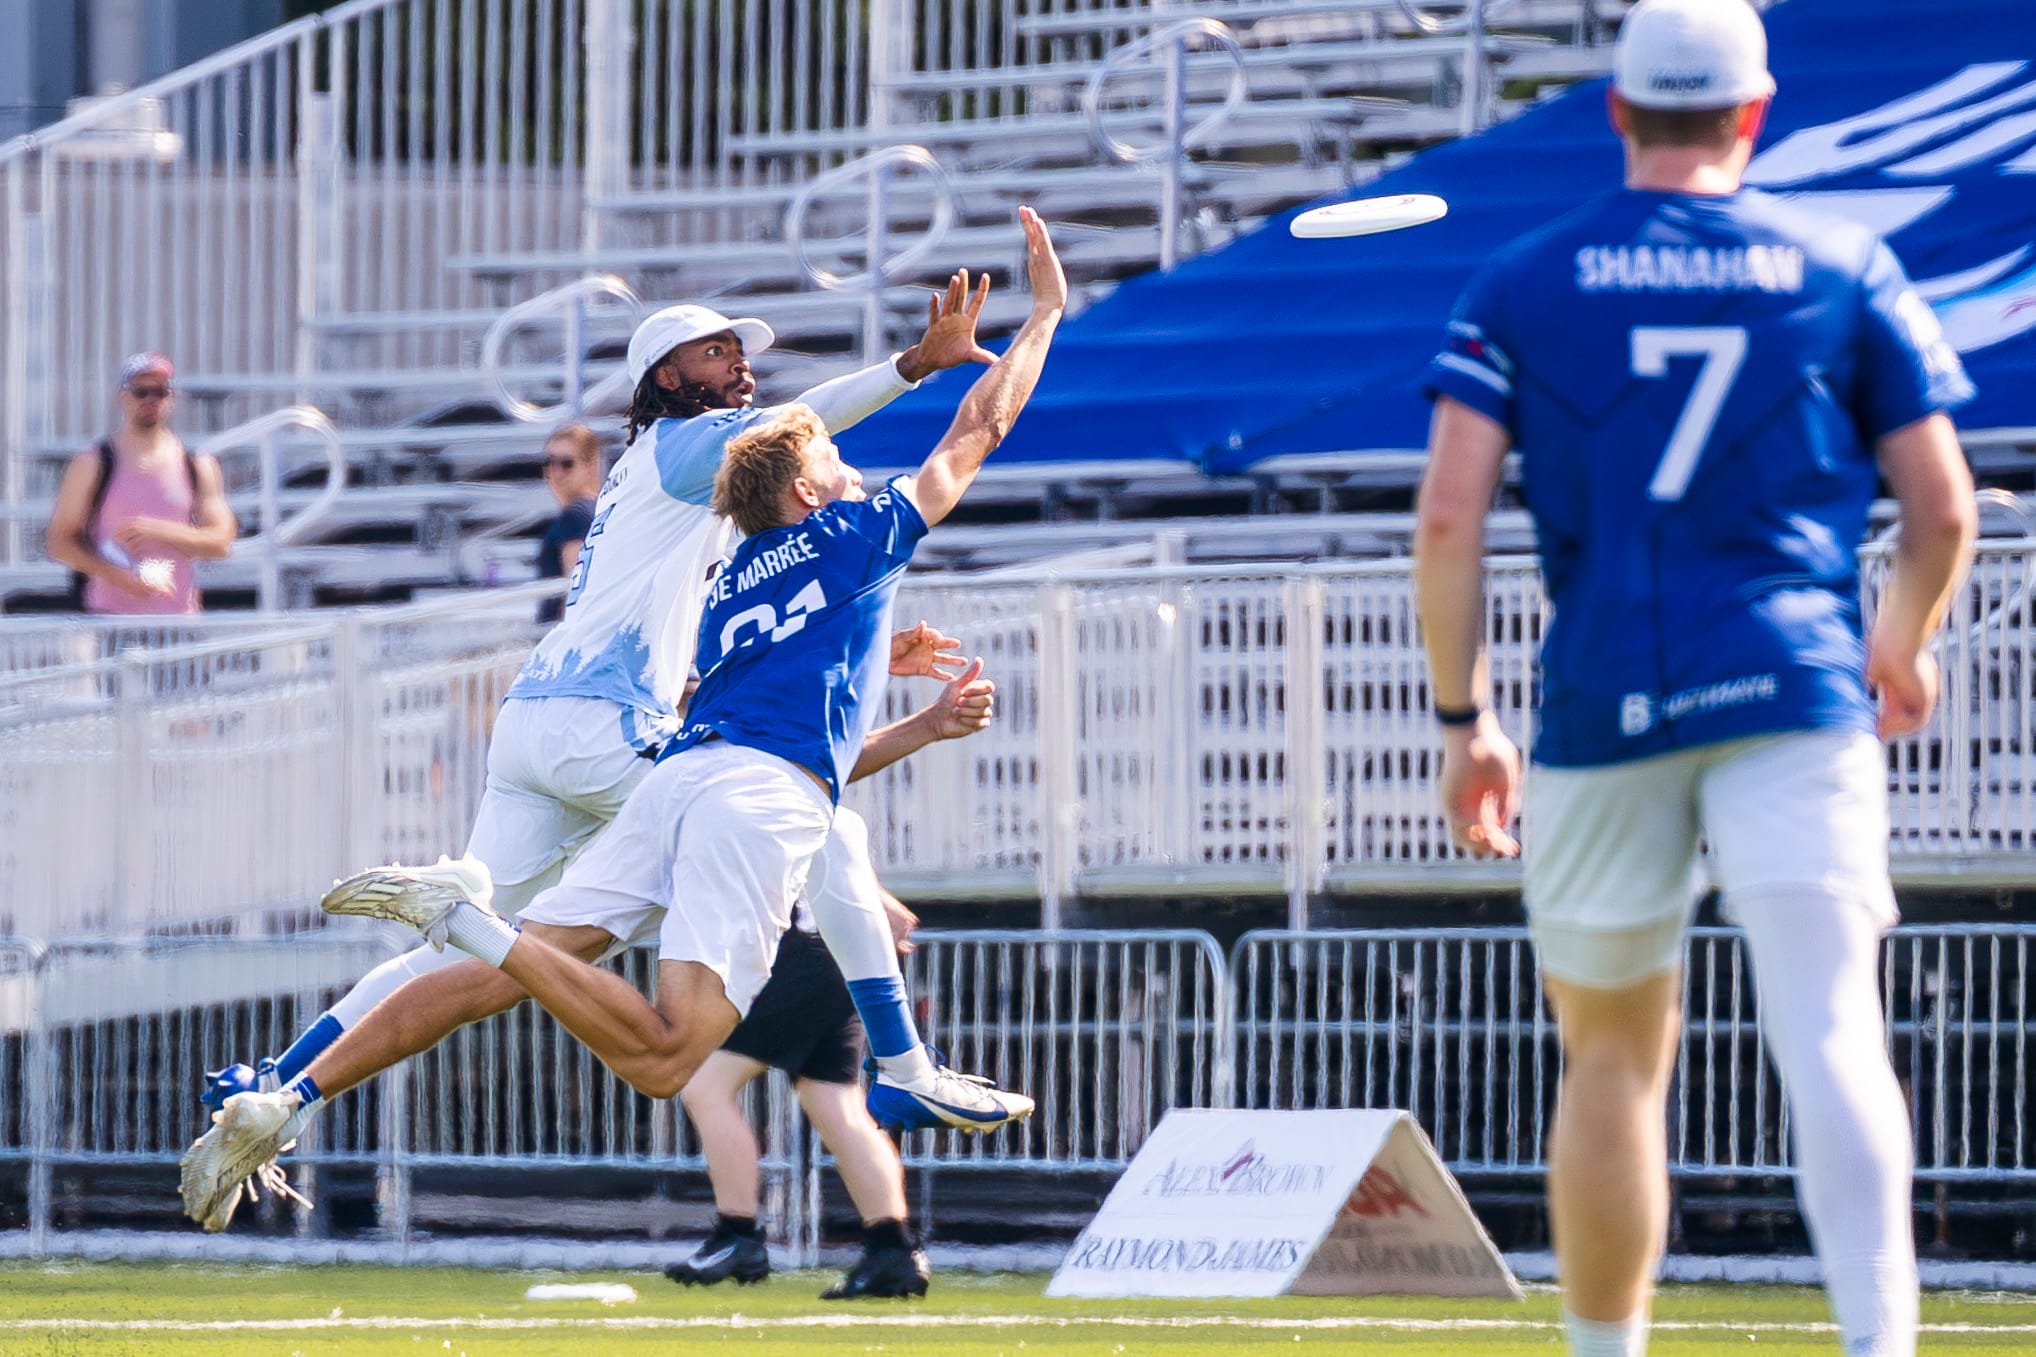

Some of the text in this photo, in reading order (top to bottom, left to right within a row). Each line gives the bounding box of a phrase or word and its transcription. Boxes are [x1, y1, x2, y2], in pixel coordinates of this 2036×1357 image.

[1575, 244, 1804, 292] SHANAHAN
[1629, 325, 1749, 502] 7
[737, 532, 820, 593] MARRÉE
